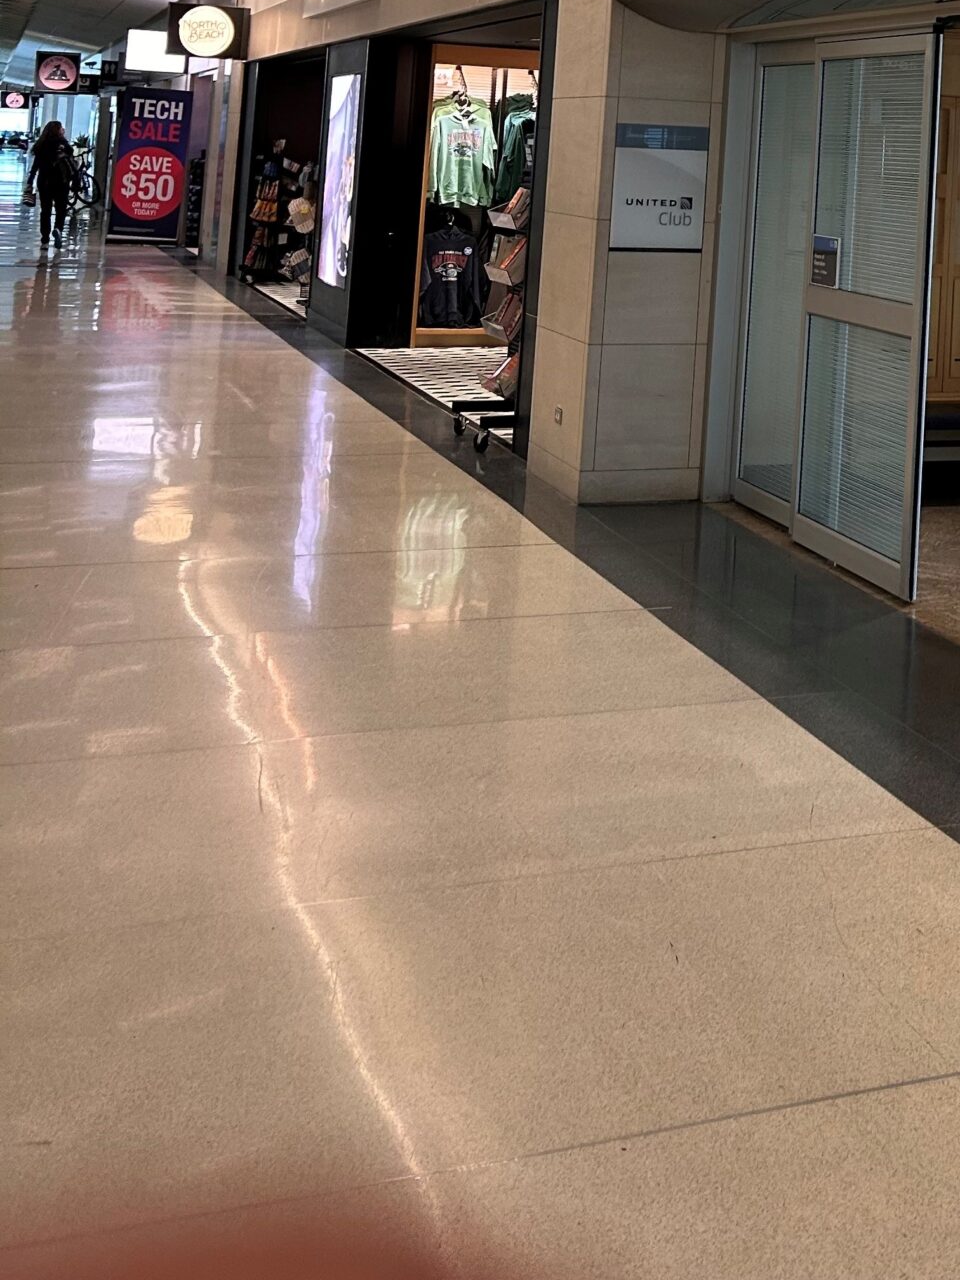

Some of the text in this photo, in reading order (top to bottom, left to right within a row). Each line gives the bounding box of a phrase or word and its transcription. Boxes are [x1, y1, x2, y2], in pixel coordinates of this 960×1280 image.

[131, 98, 184, 121] TECH
[128, 120, 182, 143] SALE
[129, 154, 173, 173] SAVE
[120, 172, 175, 202] $50
[131, 201, 160, 210] OR MORE
[625, 198, 678, 208] UNITED
[133, 208, 157, 217] TODAY!
[658, 211, 693, 227] Club
